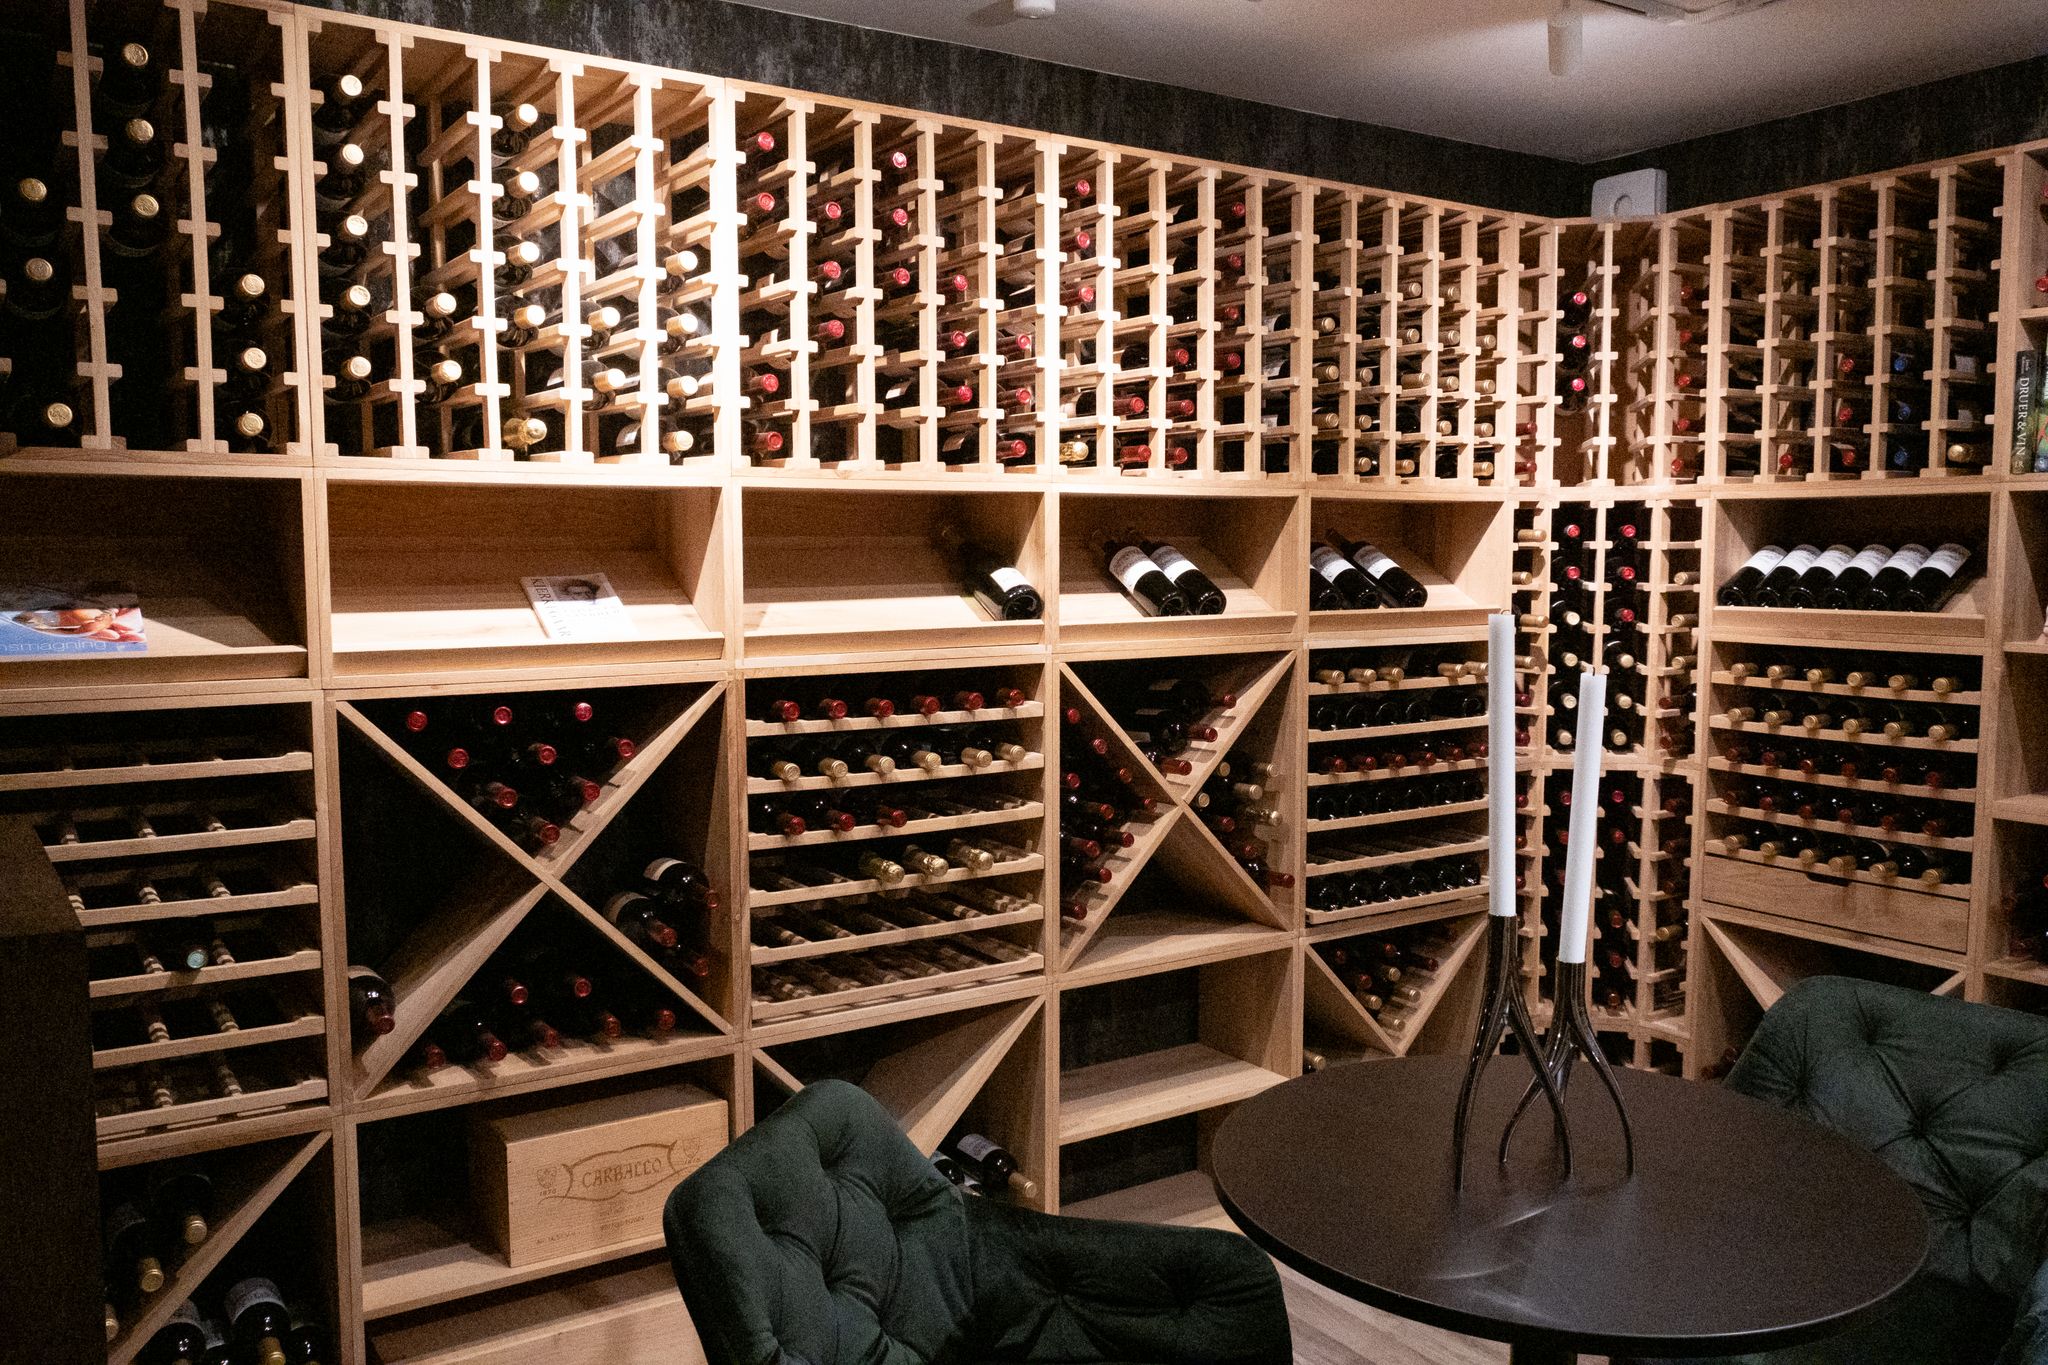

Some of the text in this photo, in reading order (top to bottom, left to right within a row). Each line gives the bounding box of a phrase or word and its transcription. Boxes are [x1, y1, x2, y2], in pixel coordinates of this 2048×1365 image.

[2017, 377, 2030, 420] DRUER
[2016, 421, 2027, 431] &
[2015, 433, 2027, 456] VIN
